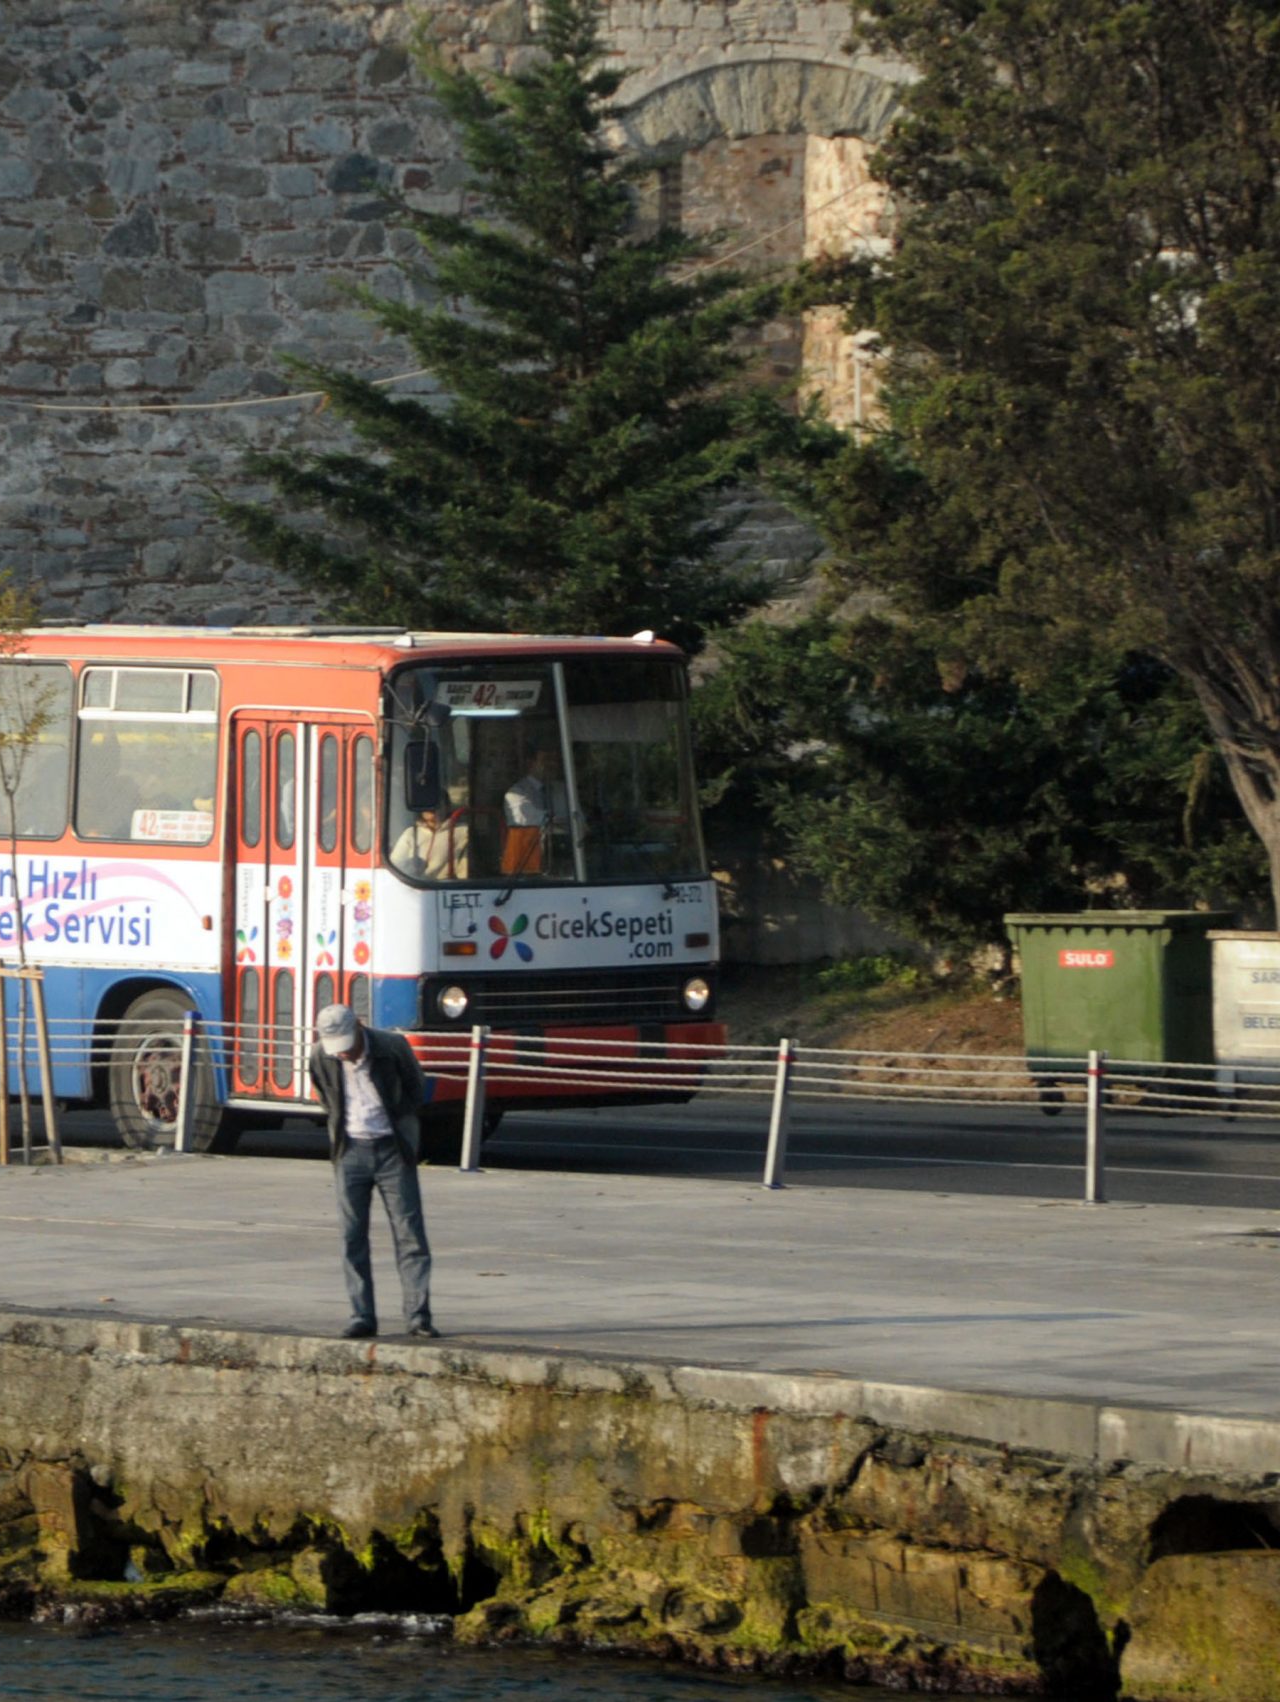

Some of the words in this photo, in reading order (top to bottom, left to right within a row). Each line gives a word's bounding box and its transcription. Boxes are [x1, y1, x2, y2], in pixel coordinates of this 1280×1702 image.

[473, 684, 497, 707] 42
[139, 811, 157, 836] 42
[28, 859, 97, 900] Hızlı
[44, 903, 151, 947] Servisi
[535, 910, 672, 942] CicekSepeti
[629, 941, 672, 959] .com
[1065, 953, 1107, 965] SULO
